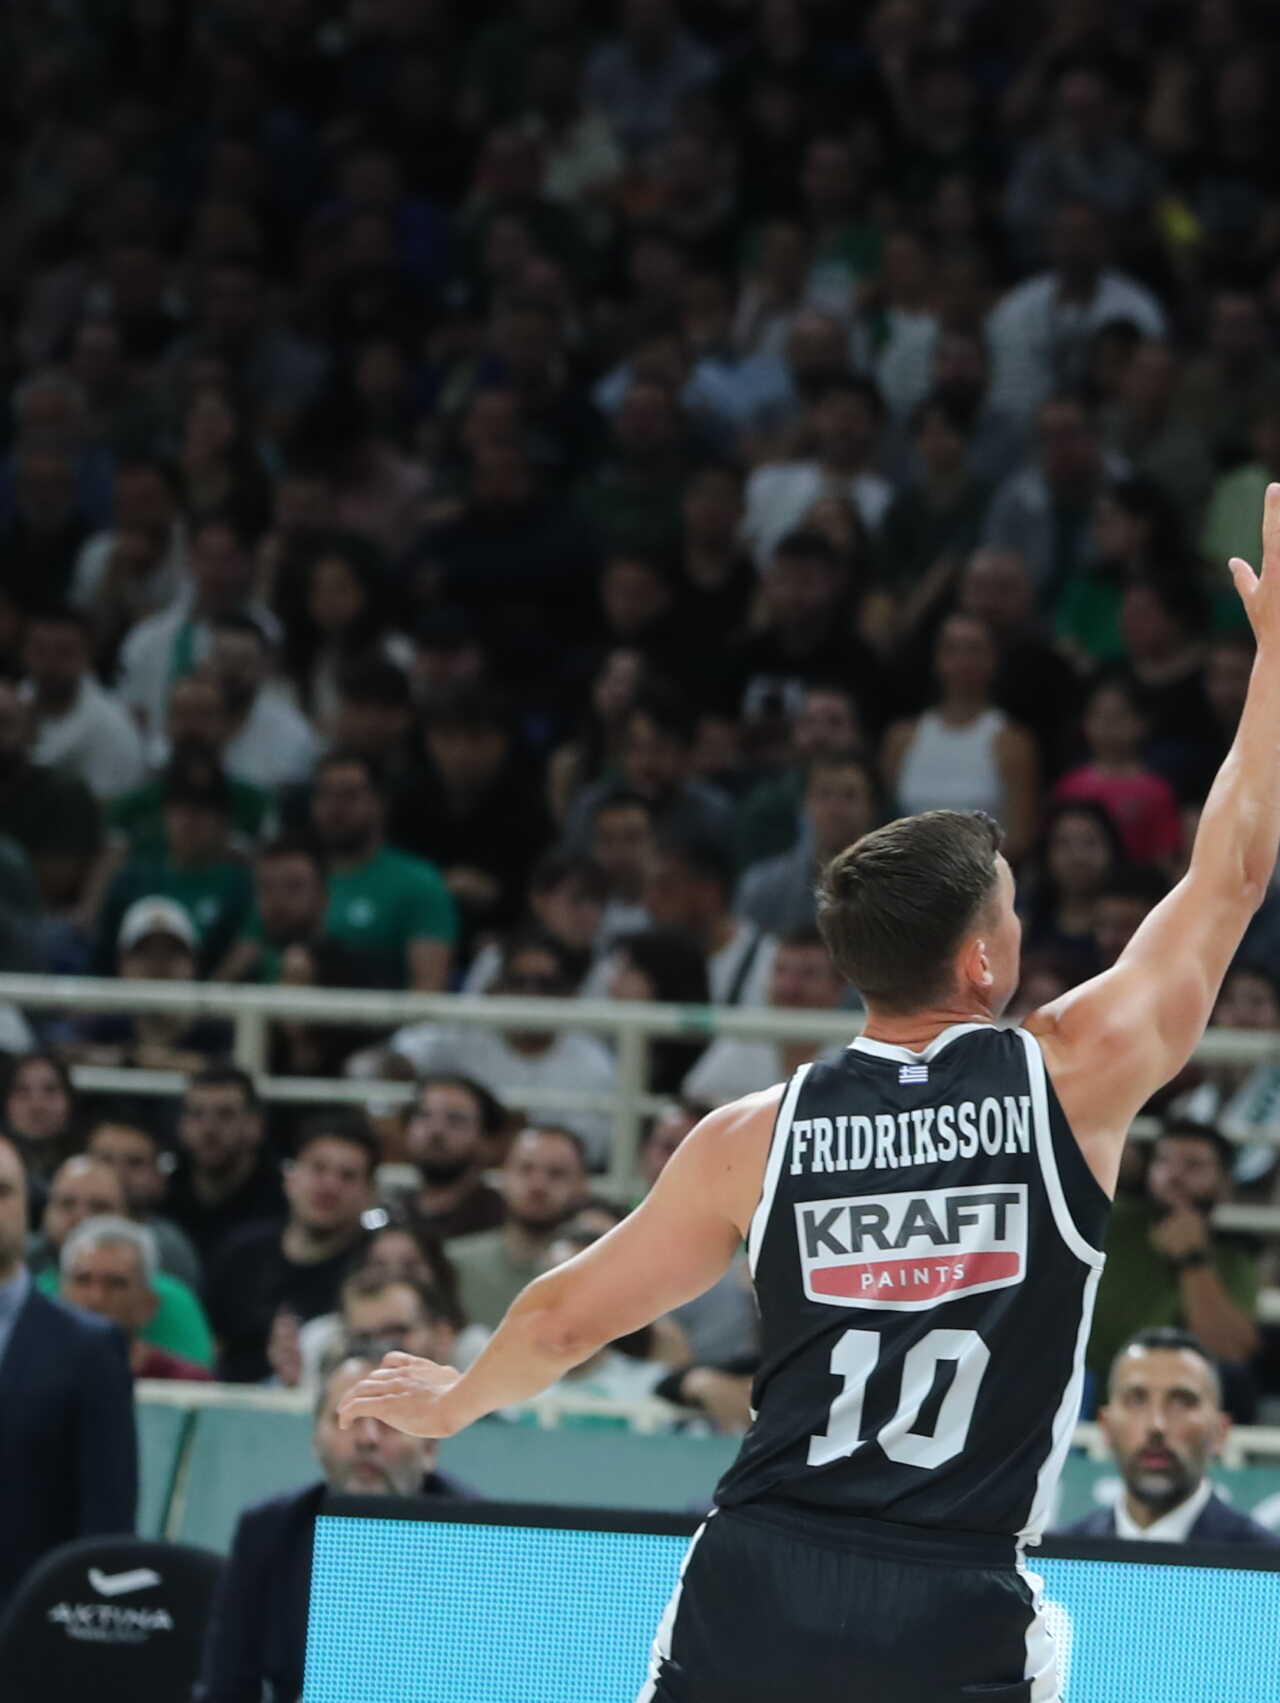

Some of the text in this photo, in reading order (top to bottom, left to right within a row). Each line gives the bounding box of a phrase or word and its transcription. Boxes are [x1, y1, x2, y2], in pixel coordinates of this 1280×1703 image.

[790, 1095, 1031, 1175] FRIDRIKSSON
[802, 1192, 1020, 1258] KRAFT
[860, 1263, 966, 1291] PAINTS
[806, 1328, 991, 1470] 10
